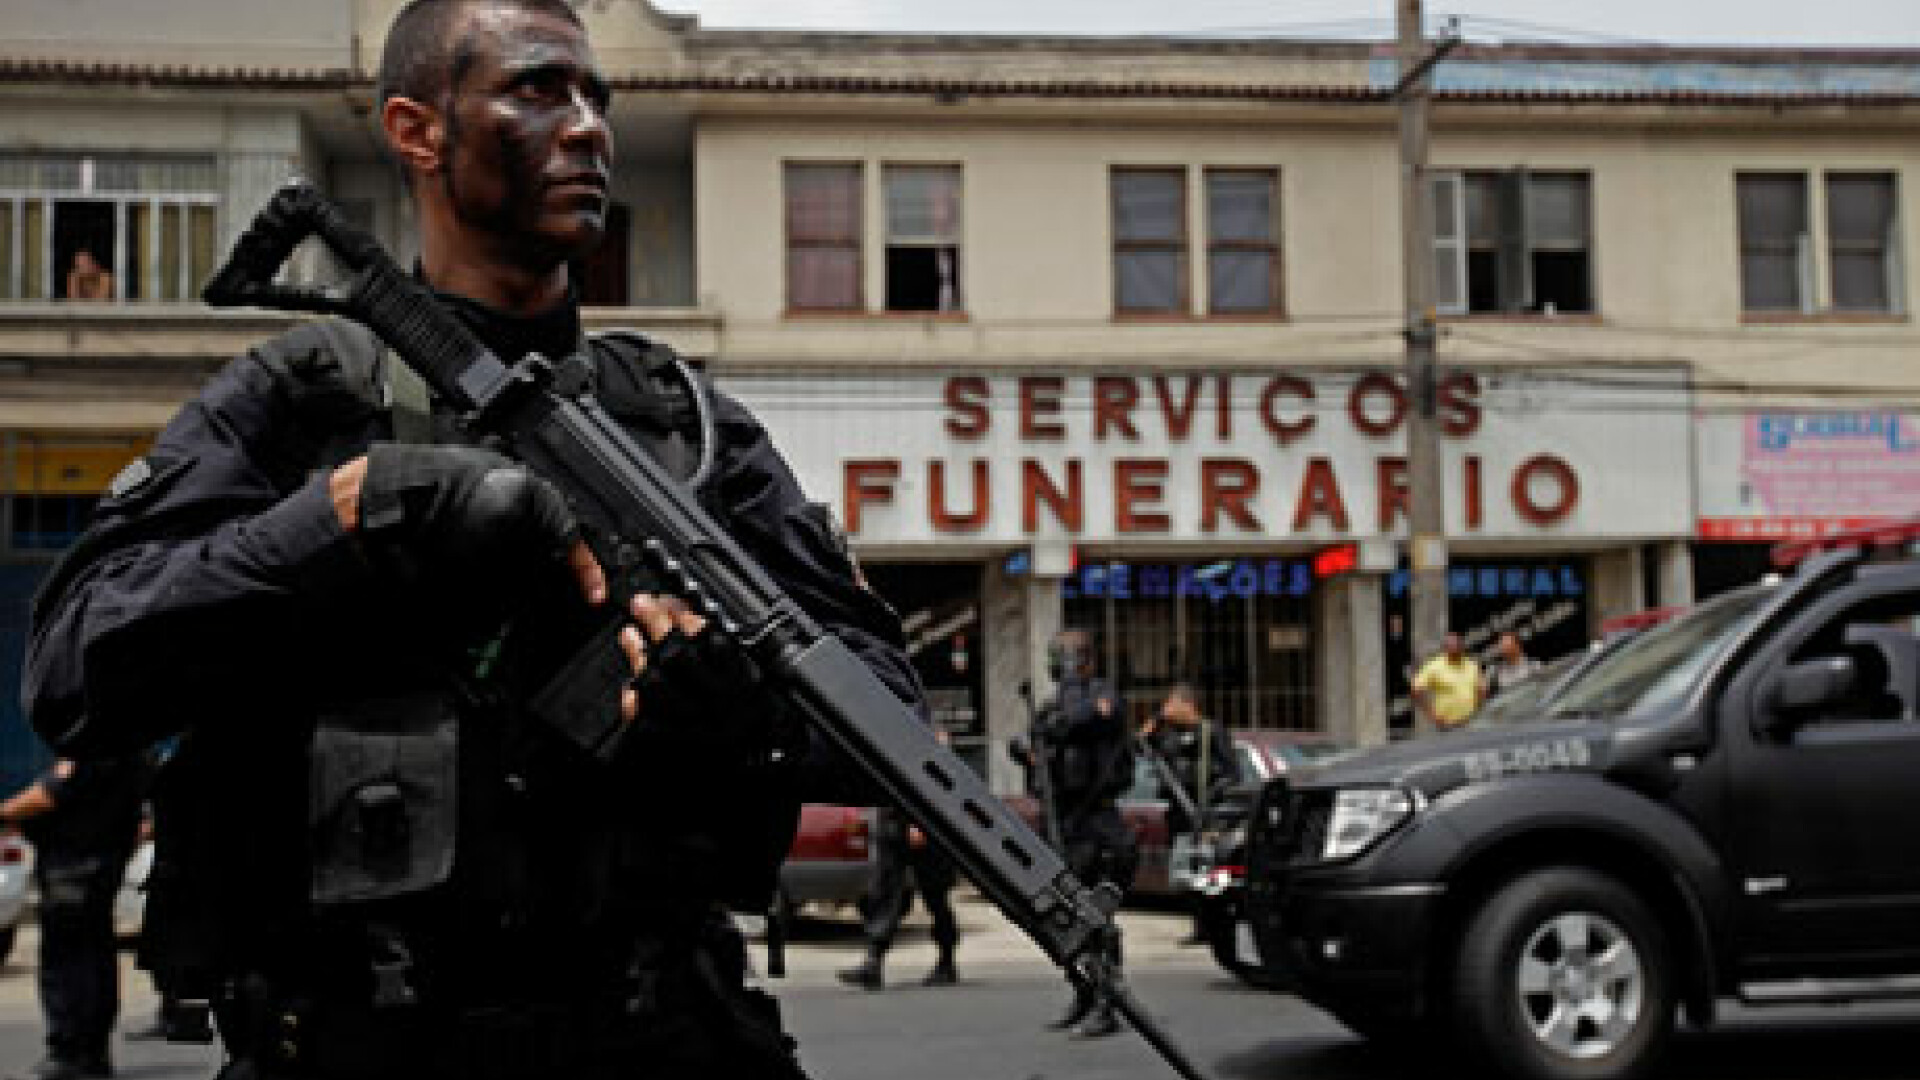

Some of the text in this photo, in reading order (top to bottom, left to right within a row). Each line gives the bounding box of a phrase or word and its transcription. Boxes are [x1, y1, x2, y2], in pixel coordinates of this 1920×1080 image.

[942, 373, 1483, 444] SERVIÇOS
[843, 454, 1581, 532] FUNERARIO
[1388, 565, 1583, 597] FNERAL
